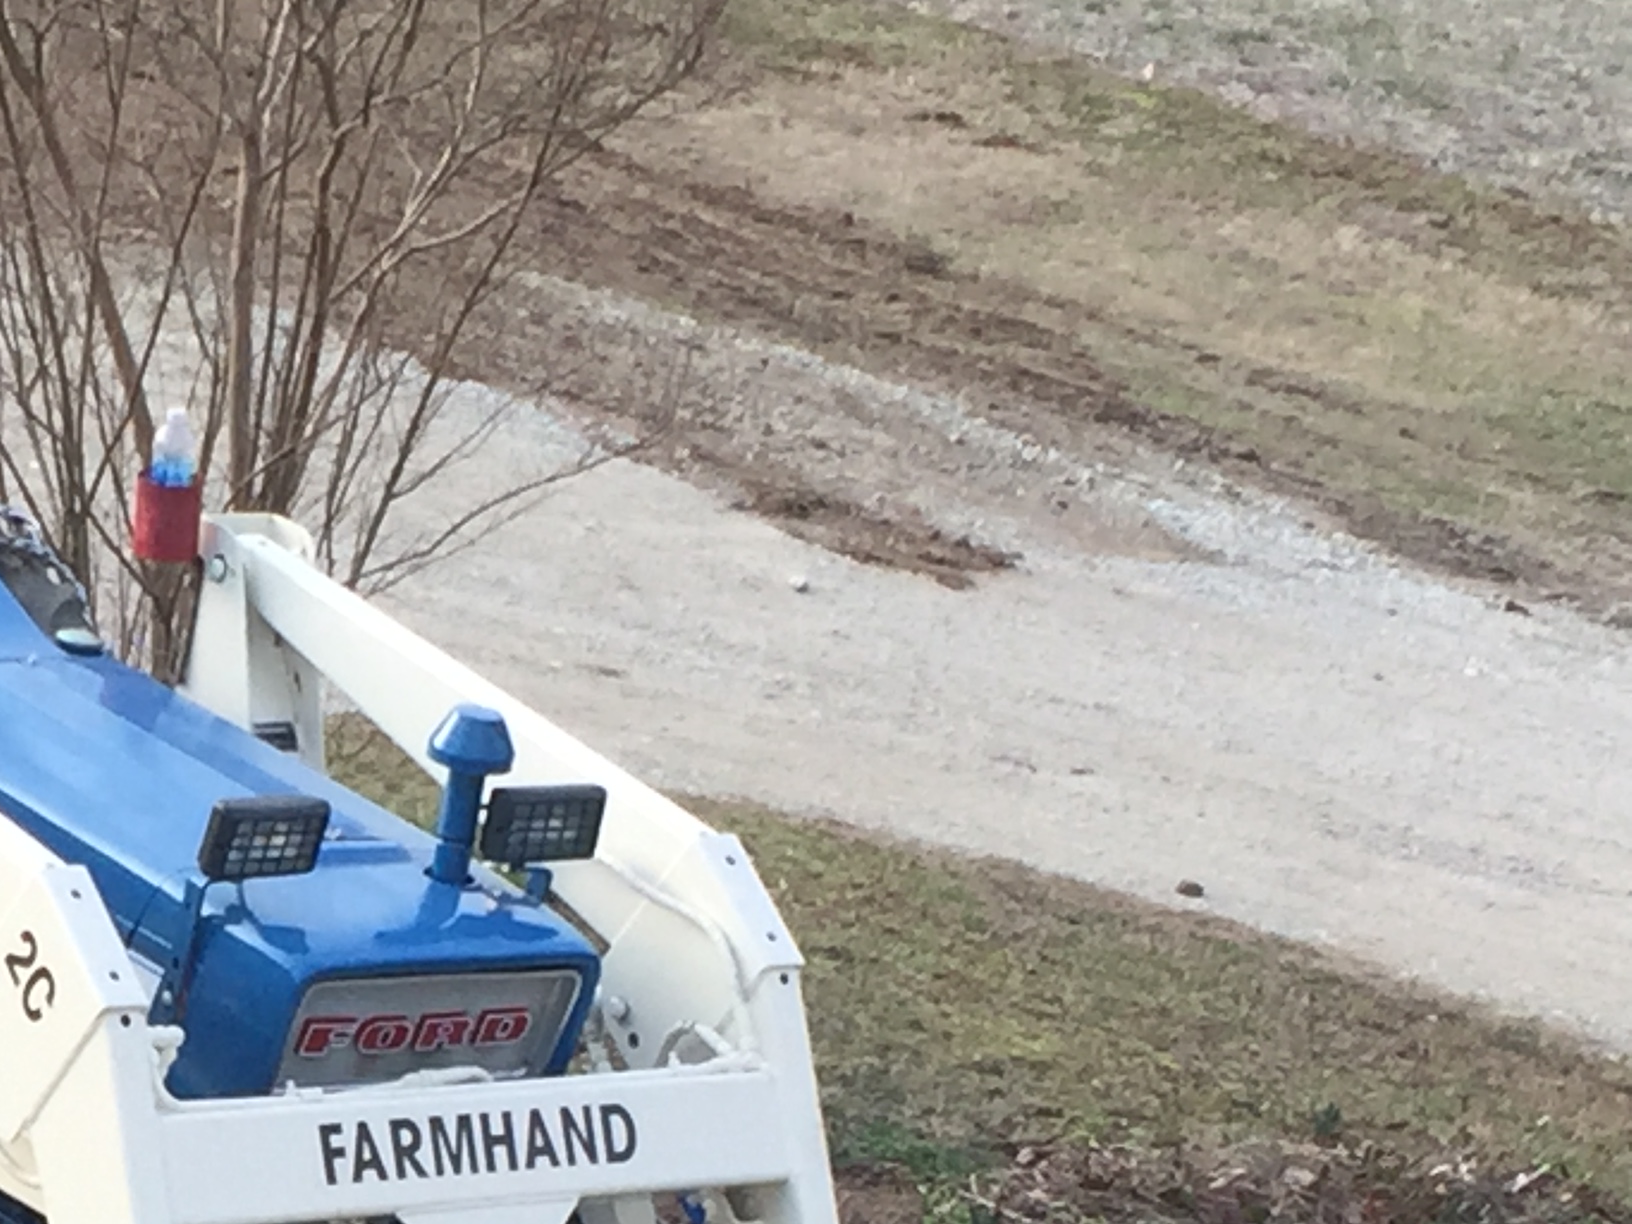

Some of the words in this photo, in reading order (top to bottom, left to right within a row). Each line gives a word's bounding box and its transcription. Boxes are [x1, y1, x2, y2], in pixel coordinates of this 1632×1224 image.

[4, 930, 56, 1022] 2C
[294, 1006, 533, 1057] FORD
[318, 1103, 637, 1185] FARMHAND
